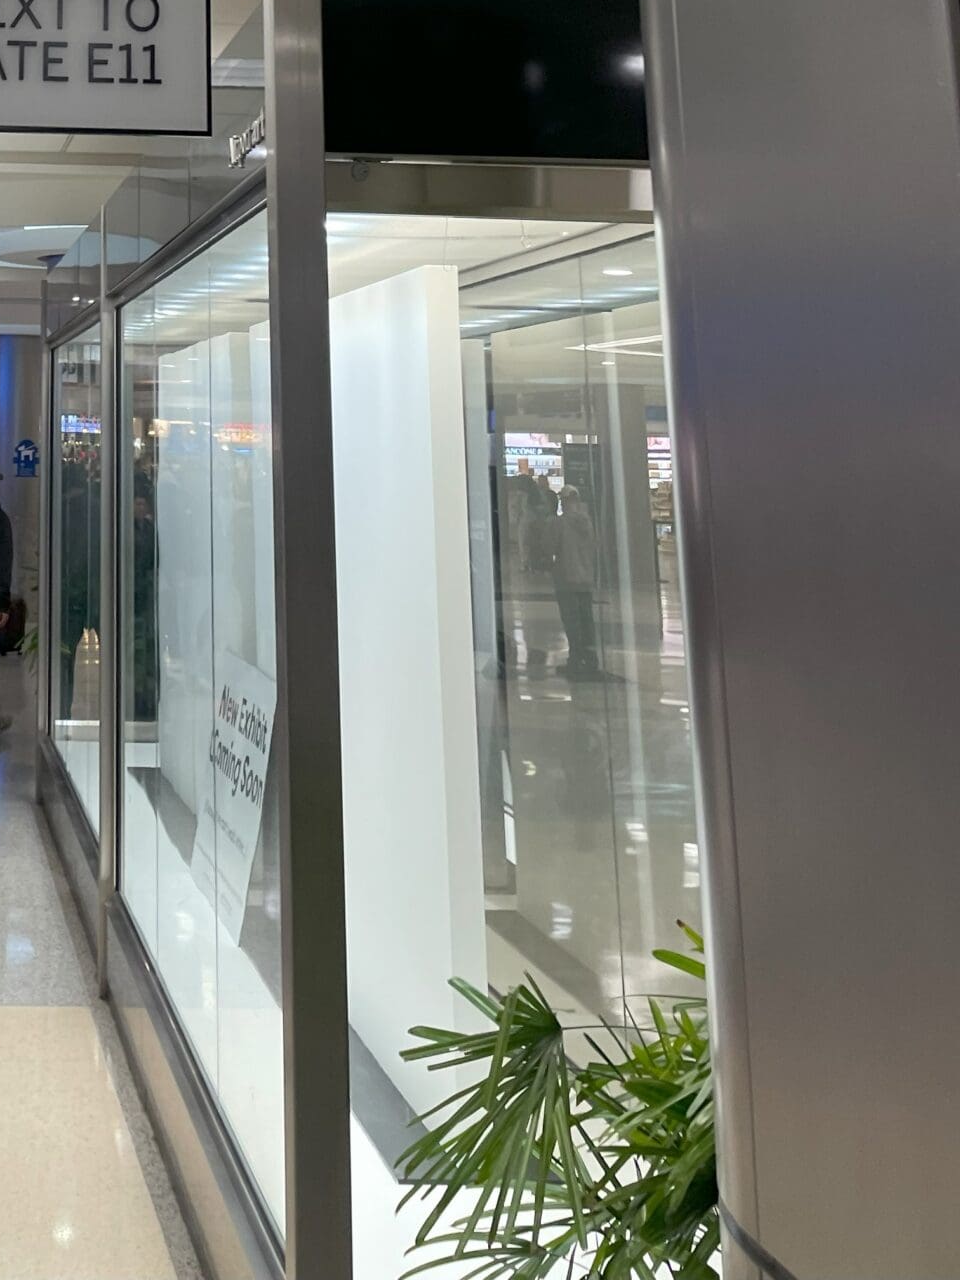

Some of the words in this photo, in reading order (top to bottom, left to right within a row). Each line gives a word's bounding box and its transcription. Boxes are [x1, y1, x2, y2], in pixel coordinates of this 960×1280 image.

[87, 42, 163, 85] E11
[218, 684, 239, 728] New
[238, 697, 268, 755] Exhibit
[209, 728, 242, 797] Coming
[240, 755, 263, 809] Soon
